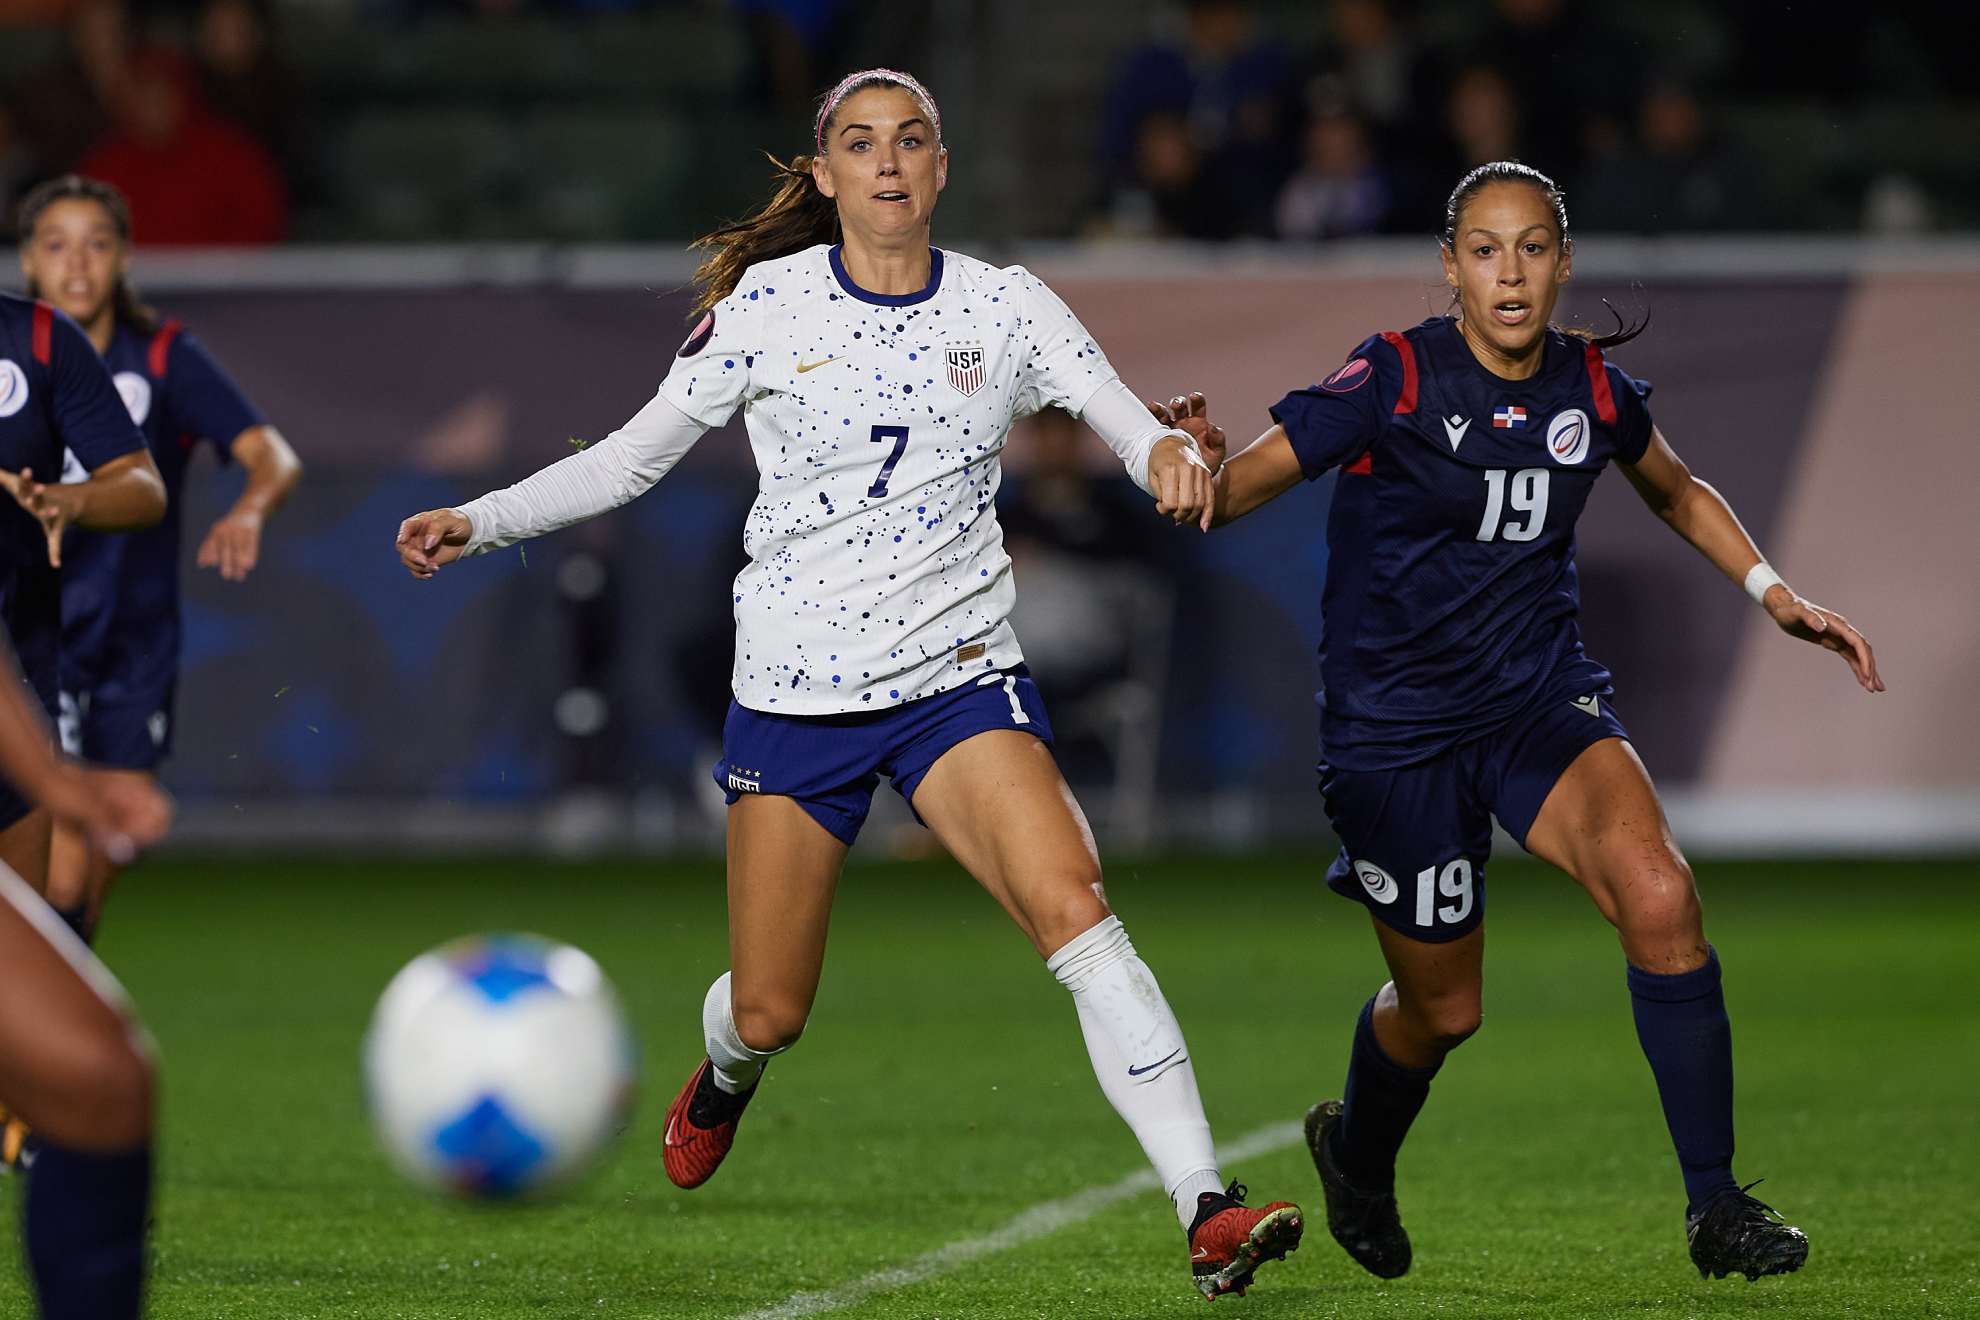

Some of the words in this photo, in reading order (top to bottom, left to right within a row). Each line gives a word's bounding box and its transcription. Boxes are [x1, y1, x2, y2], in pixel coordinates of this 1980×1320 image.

[948, 351, 981, 370] USA
[867, 424, 910, 498] 7
[1475, 468, 1550, 541] 19
[1415, 859, 1474, 926] 19
